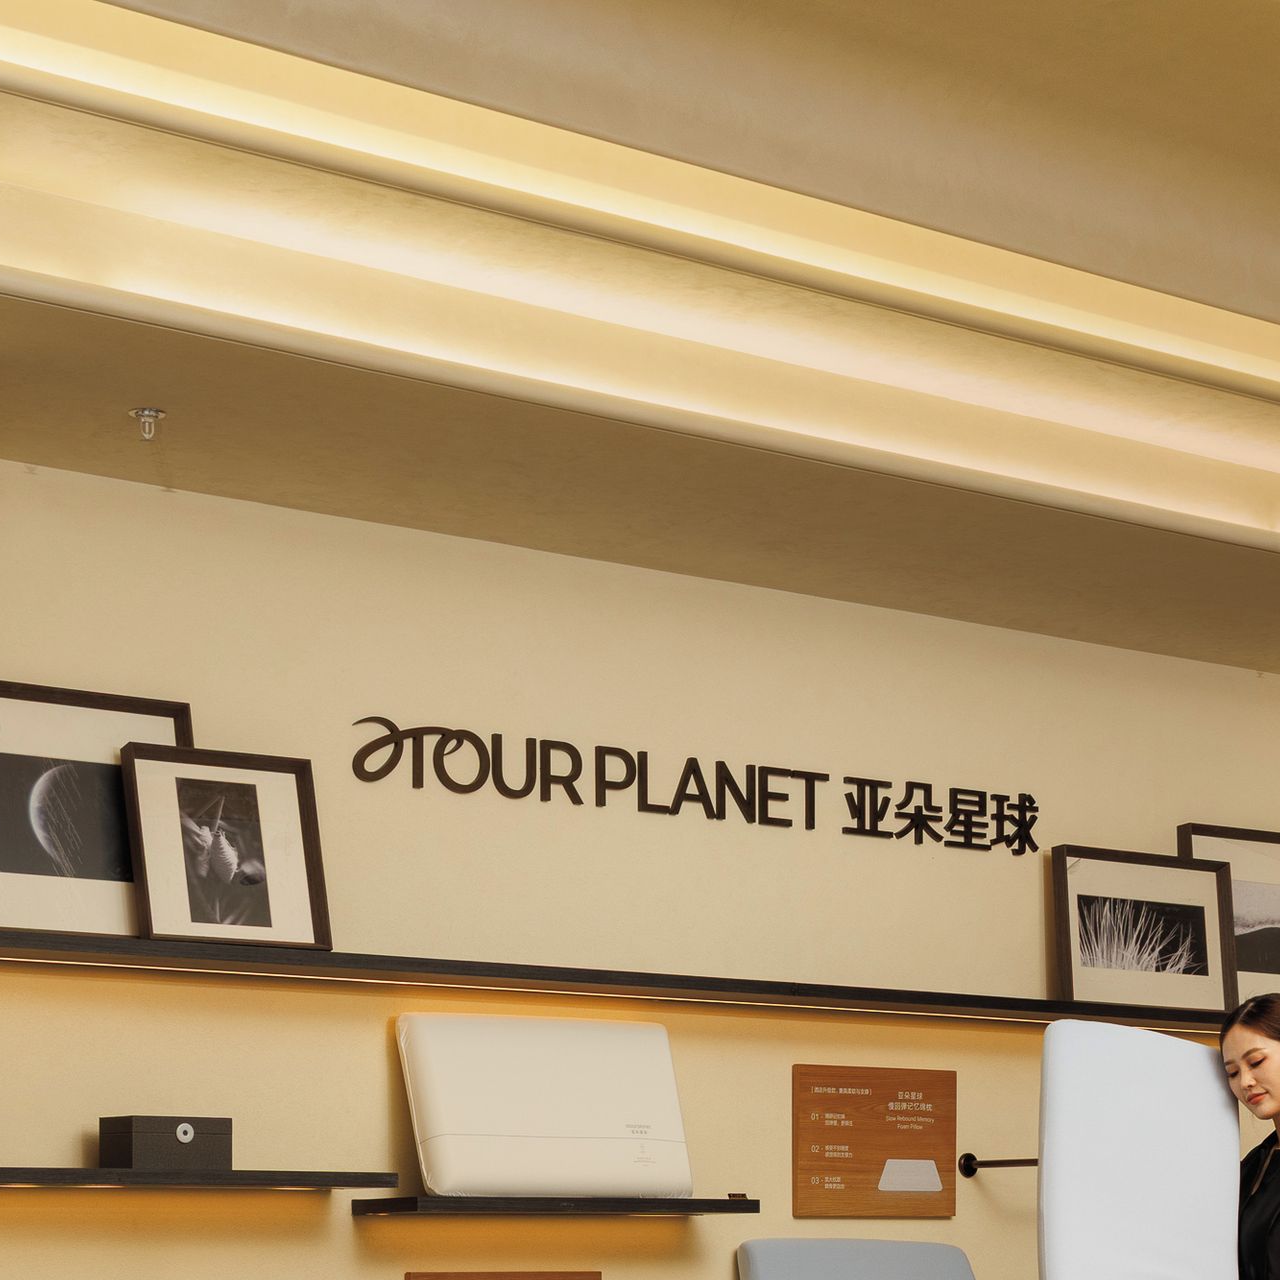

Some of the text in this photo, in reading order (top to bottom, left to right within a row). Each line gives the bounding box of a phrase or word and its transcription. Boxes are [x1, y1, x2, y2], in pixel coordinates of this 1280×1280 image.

[594, 745, 829, 830] PLANET
[842, 776, 1039, 855] 亚朵星球
